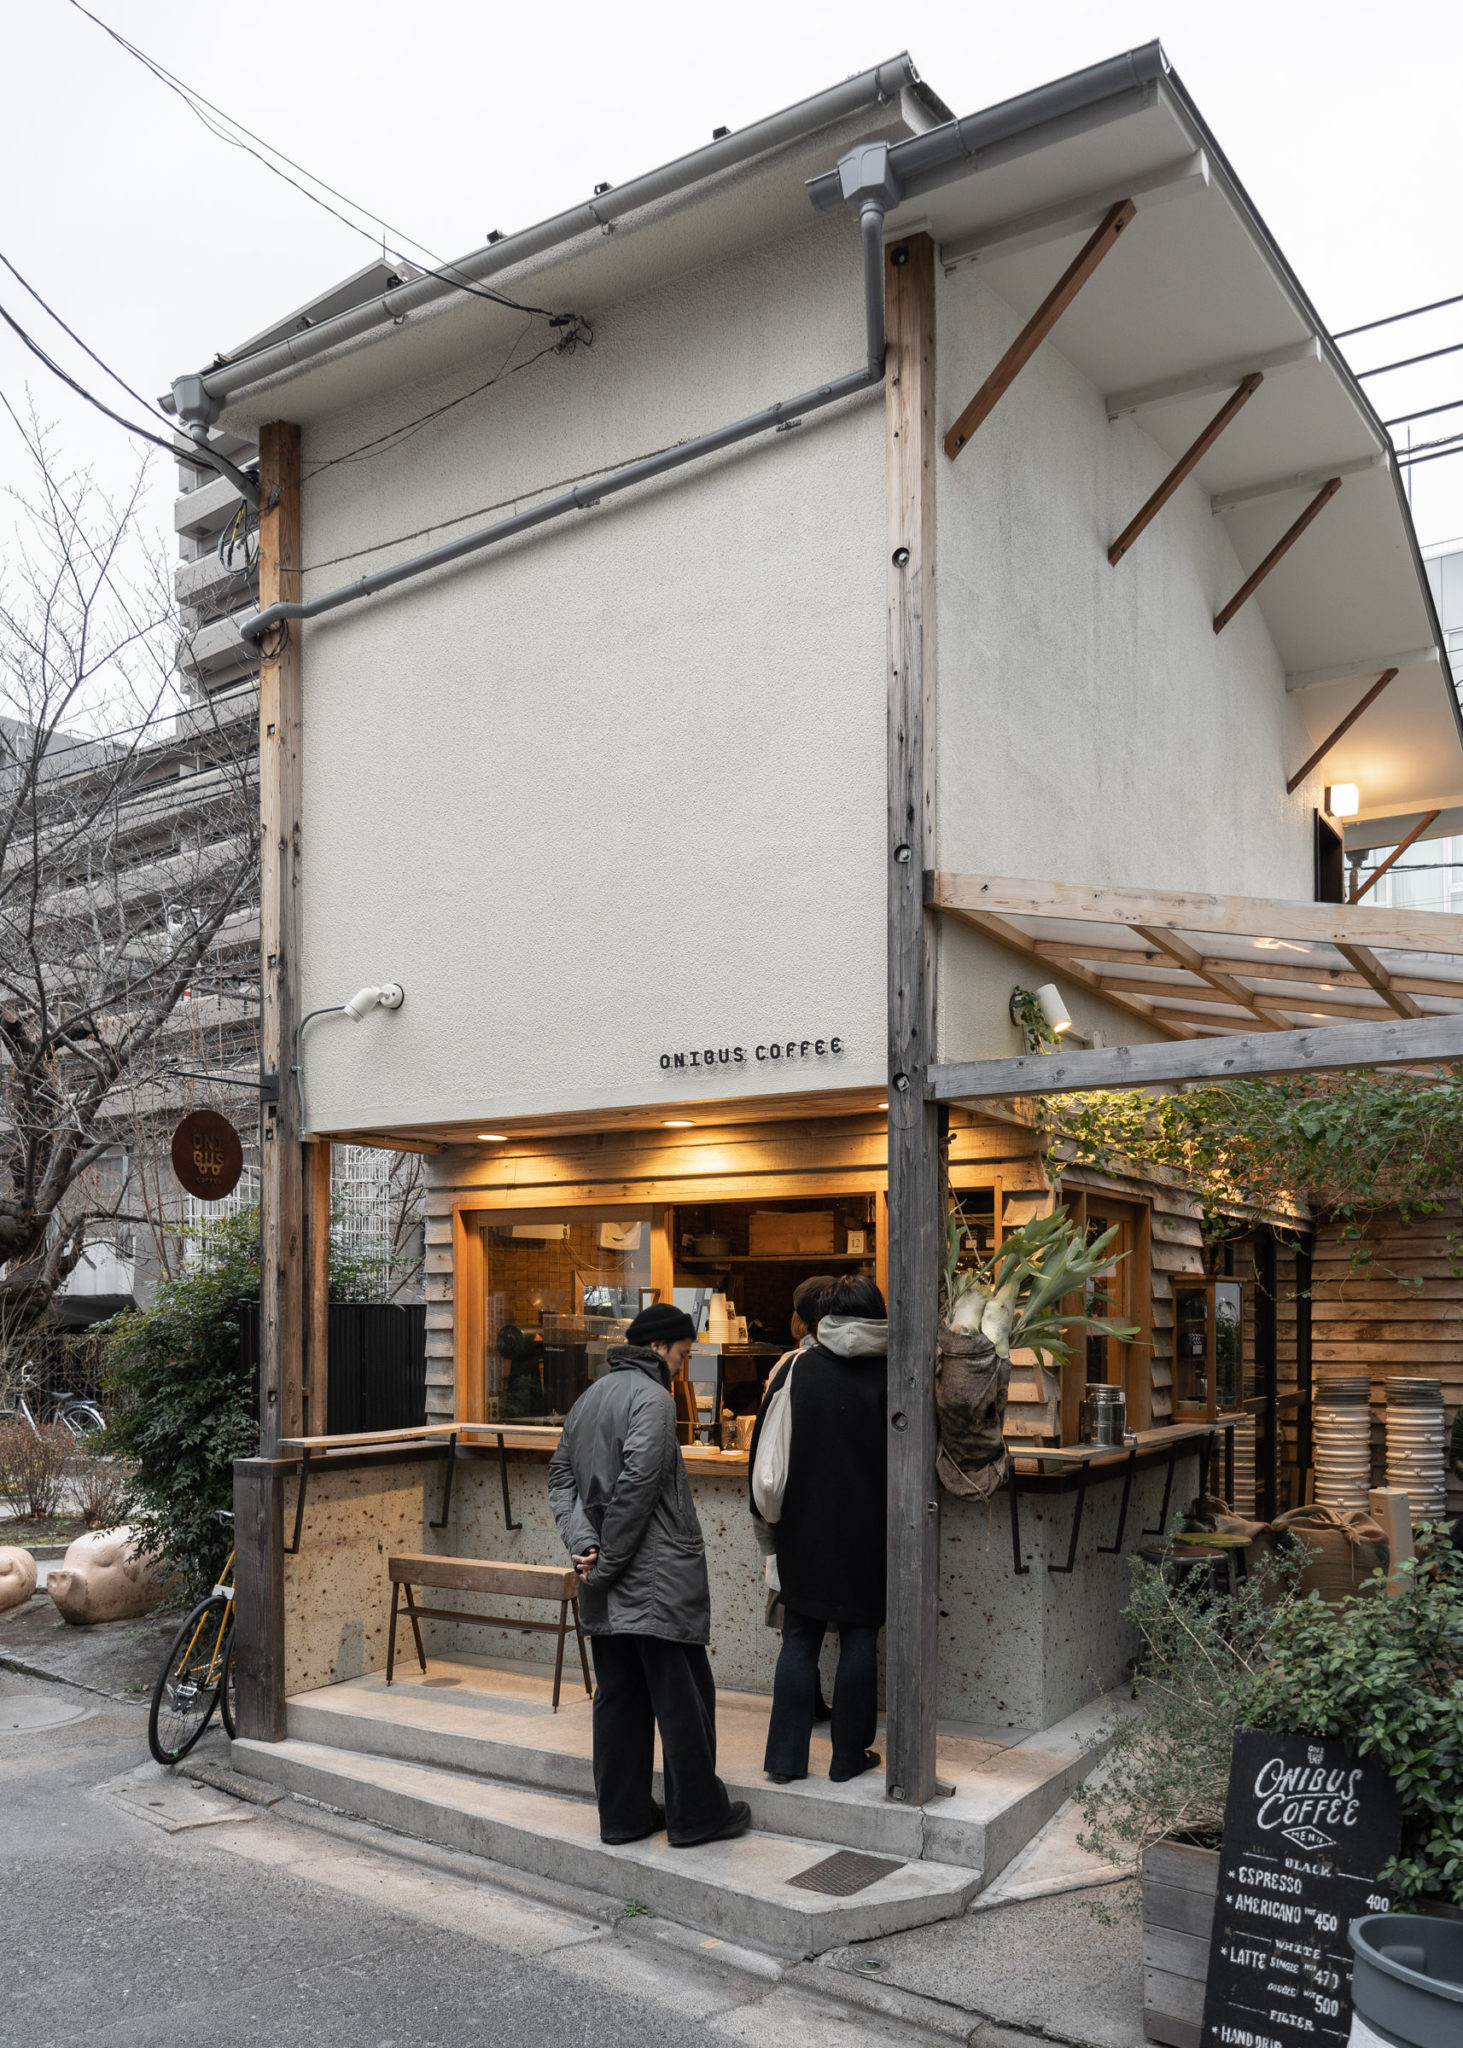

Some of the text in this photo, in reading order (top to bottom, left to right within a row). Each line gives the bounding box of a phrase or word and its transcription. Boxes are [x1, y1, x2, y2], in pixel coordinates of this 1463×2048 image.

[659, 1037, 842, 1070] ONIBUS COFFEE
[192, 1133, 224, 1151] ONI
[193, 1150, 224, 1167] BUS
[1254, 1758, 1363, 1800] ONIBUS
[1257, 1793, 1360, 1829] COFFEE
[1291, 1831, 1323, 1844] MENU
[1284, 1857, 1332, 1878] BLACK
[1238, 1866, 1389, 1912] ESPRESSO 400
[1235, 1894, 1302, 1924] AMERICANO
[1314, 1913, 1338, 1932] 450
[1230, 1946, 1267, 1970] LATTE
[1270, 1956, 1300, 1974] SINGLE
[1275, 1939, 1322, 1960] WHITE
[1314, 1994, 1340, 2017] 500
[1269, 2009, 1315, 2032] FILTER
[1221, 2025, 1254, 2047] HAND
